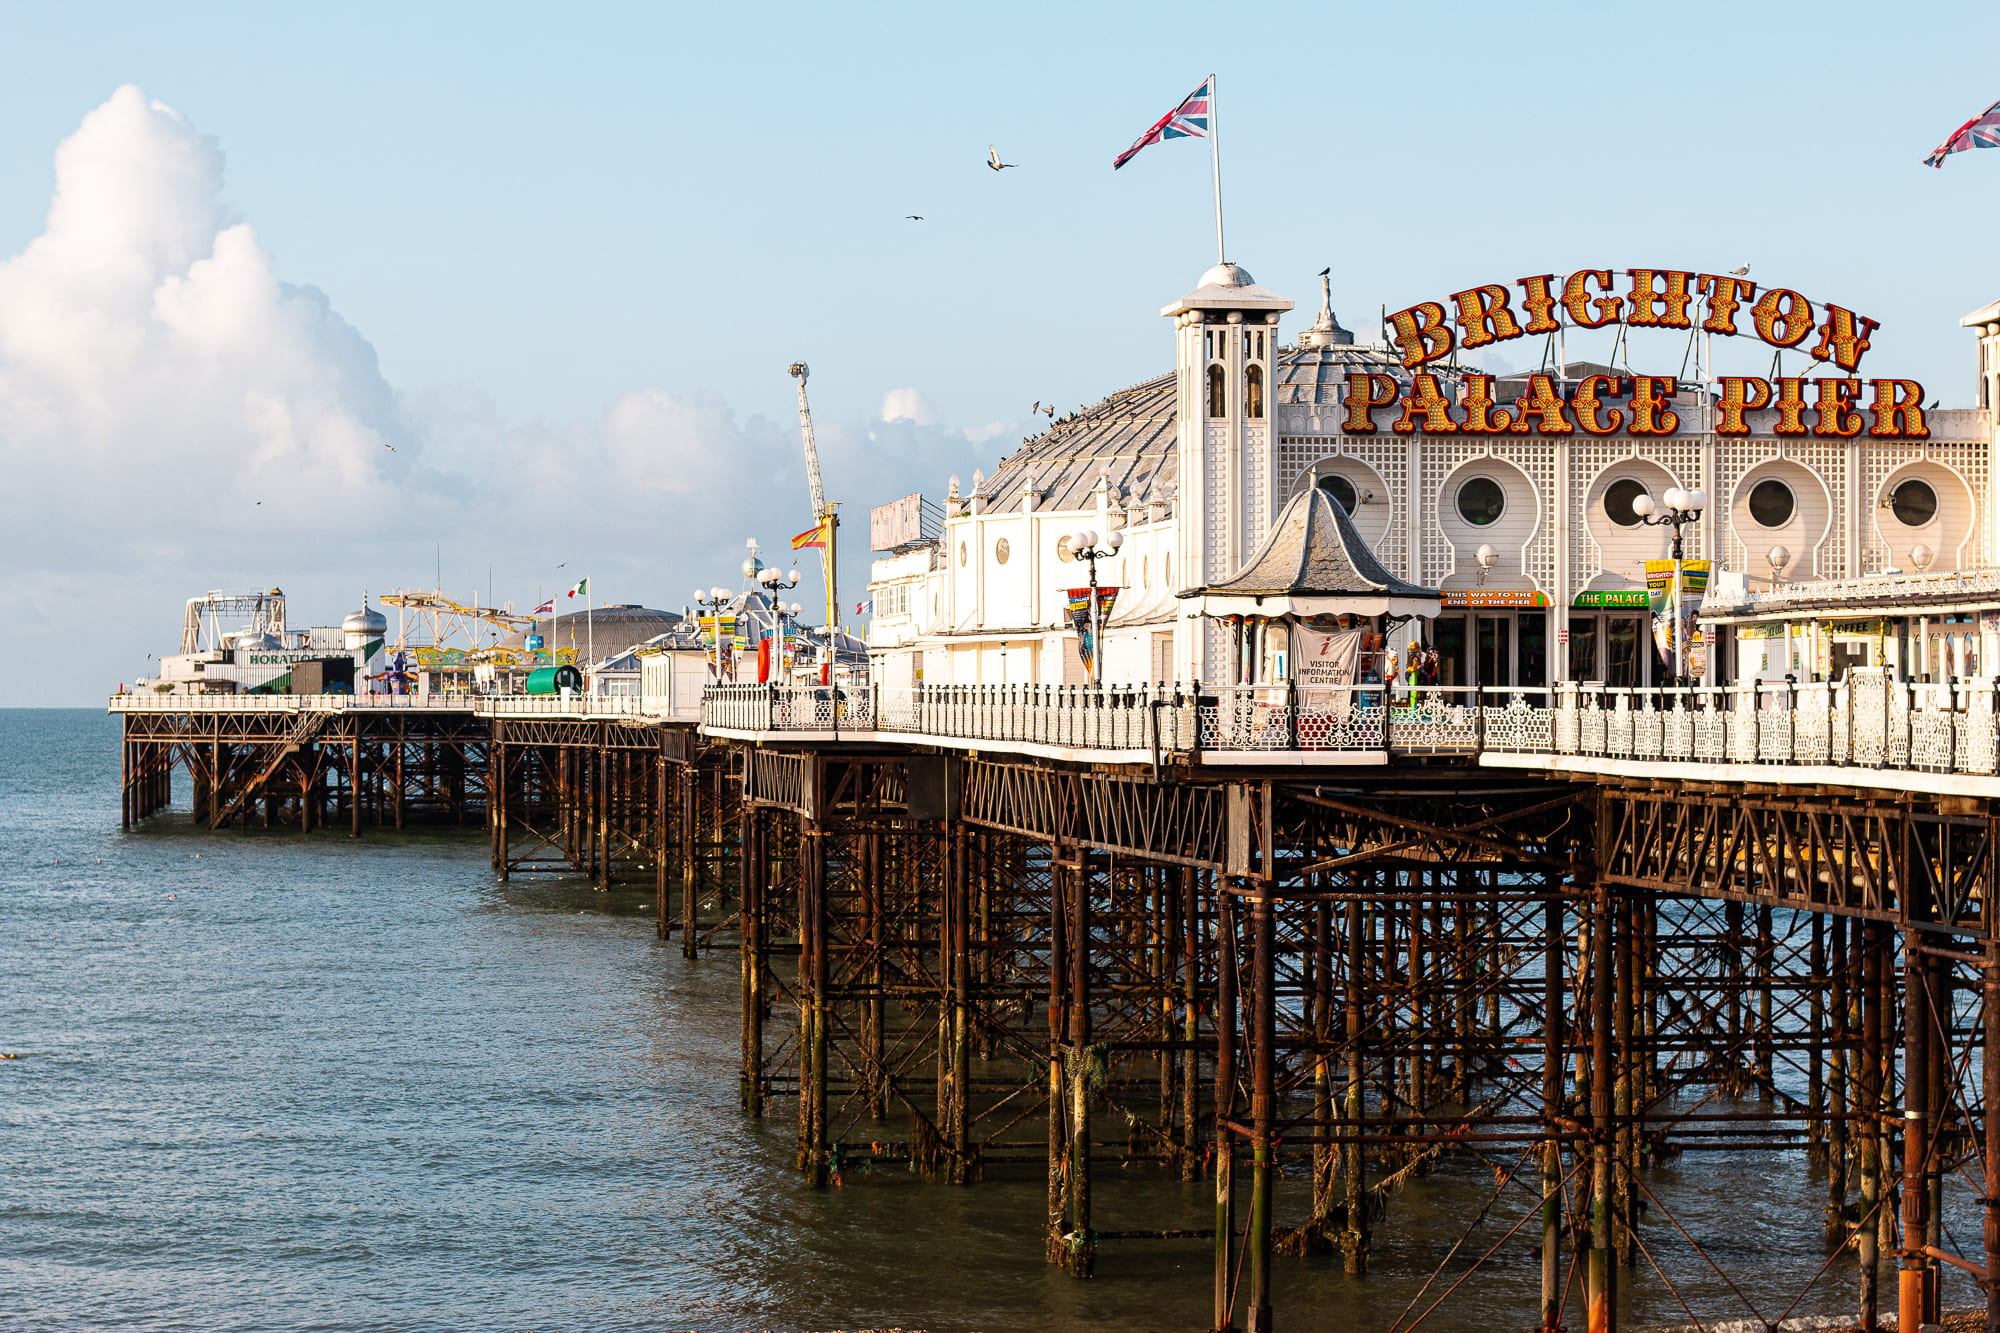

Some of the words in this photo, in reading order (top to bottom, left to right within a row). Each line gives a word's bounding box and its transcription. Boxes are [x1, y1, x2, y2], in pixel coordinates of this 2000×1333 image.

[1385, 268, 1880, 373] BRIGHTON
[1341, 373, 1680, 436] PALACE
[1715, 376, 1931, 440] PIER
[1646, 571, 1674, 580] BRIGHTON
[1580, 594, 1600, 604] THE
[1605, 593, 1646, 604] PALACE
[1310, 660, 1339, 668] VISITOR
[1299, 668, 1350, 676] INFORMATION
[1310, 676, 1339, 684] CENTRE
